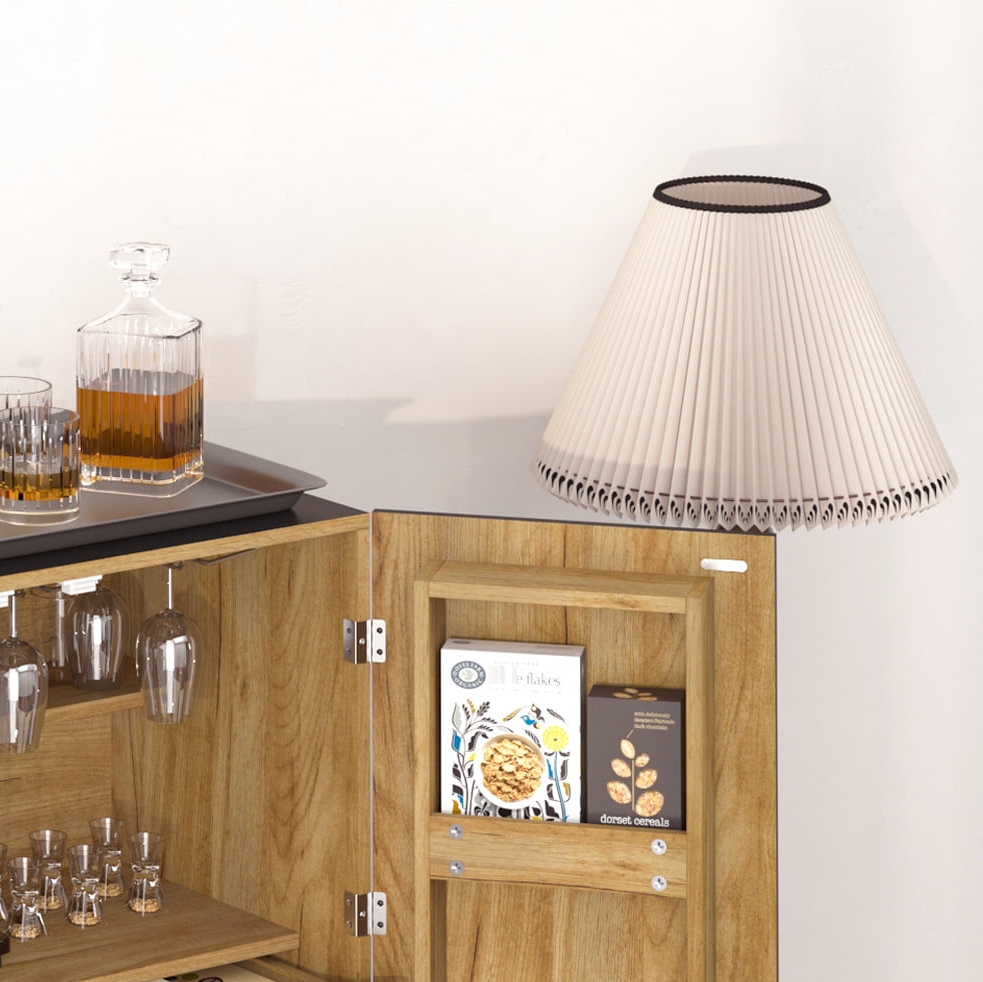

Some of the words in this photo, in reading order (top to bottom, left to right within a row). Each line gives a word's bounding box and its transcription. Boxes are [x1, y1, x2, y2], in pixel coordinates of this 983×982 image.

[526, 672, 561, 687] flakes
[600, 813, 633, 825] dorset
[634, 817, 670, 828] cereals
